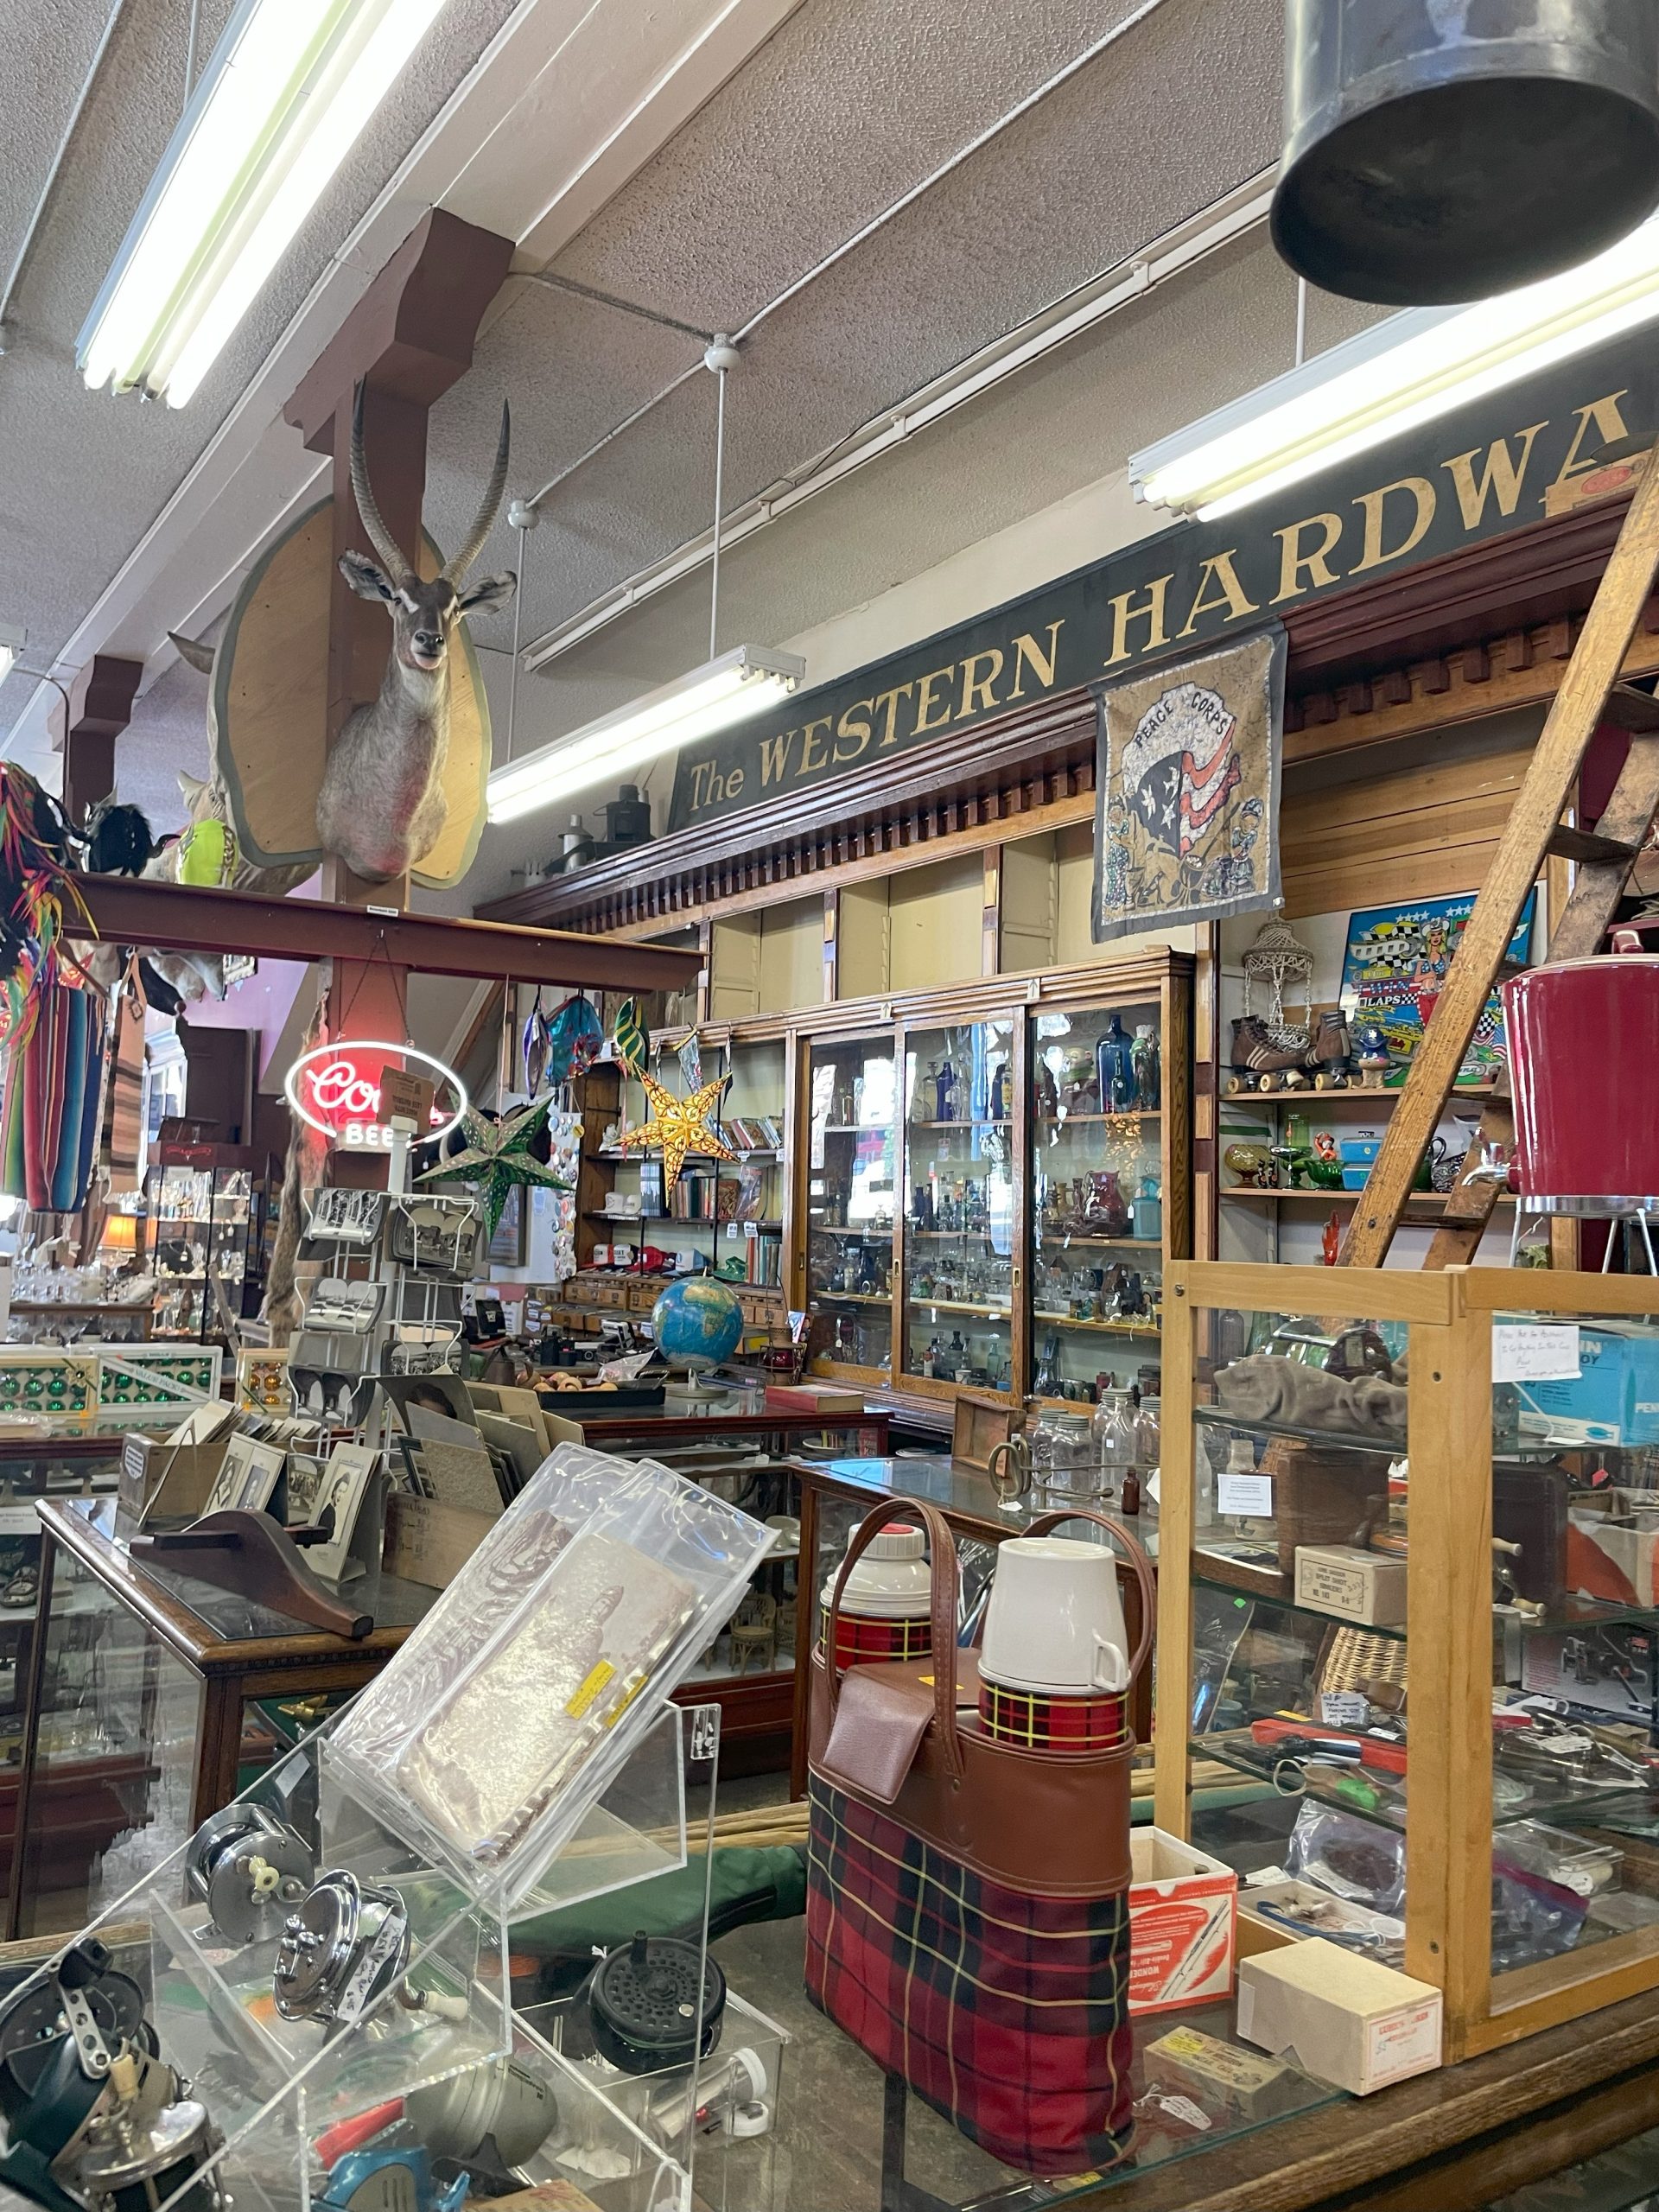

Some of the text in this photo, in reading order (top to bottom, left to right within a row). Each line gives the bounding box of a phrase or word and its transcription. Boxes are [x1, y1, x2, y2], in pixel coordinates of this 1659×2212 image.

[689, 389, 1630, 812] The WESTERN HARDWA
[1135, 691, 1229, 748] PEACE CORPS
[1367, 995, 1402, 1007] LAPS
